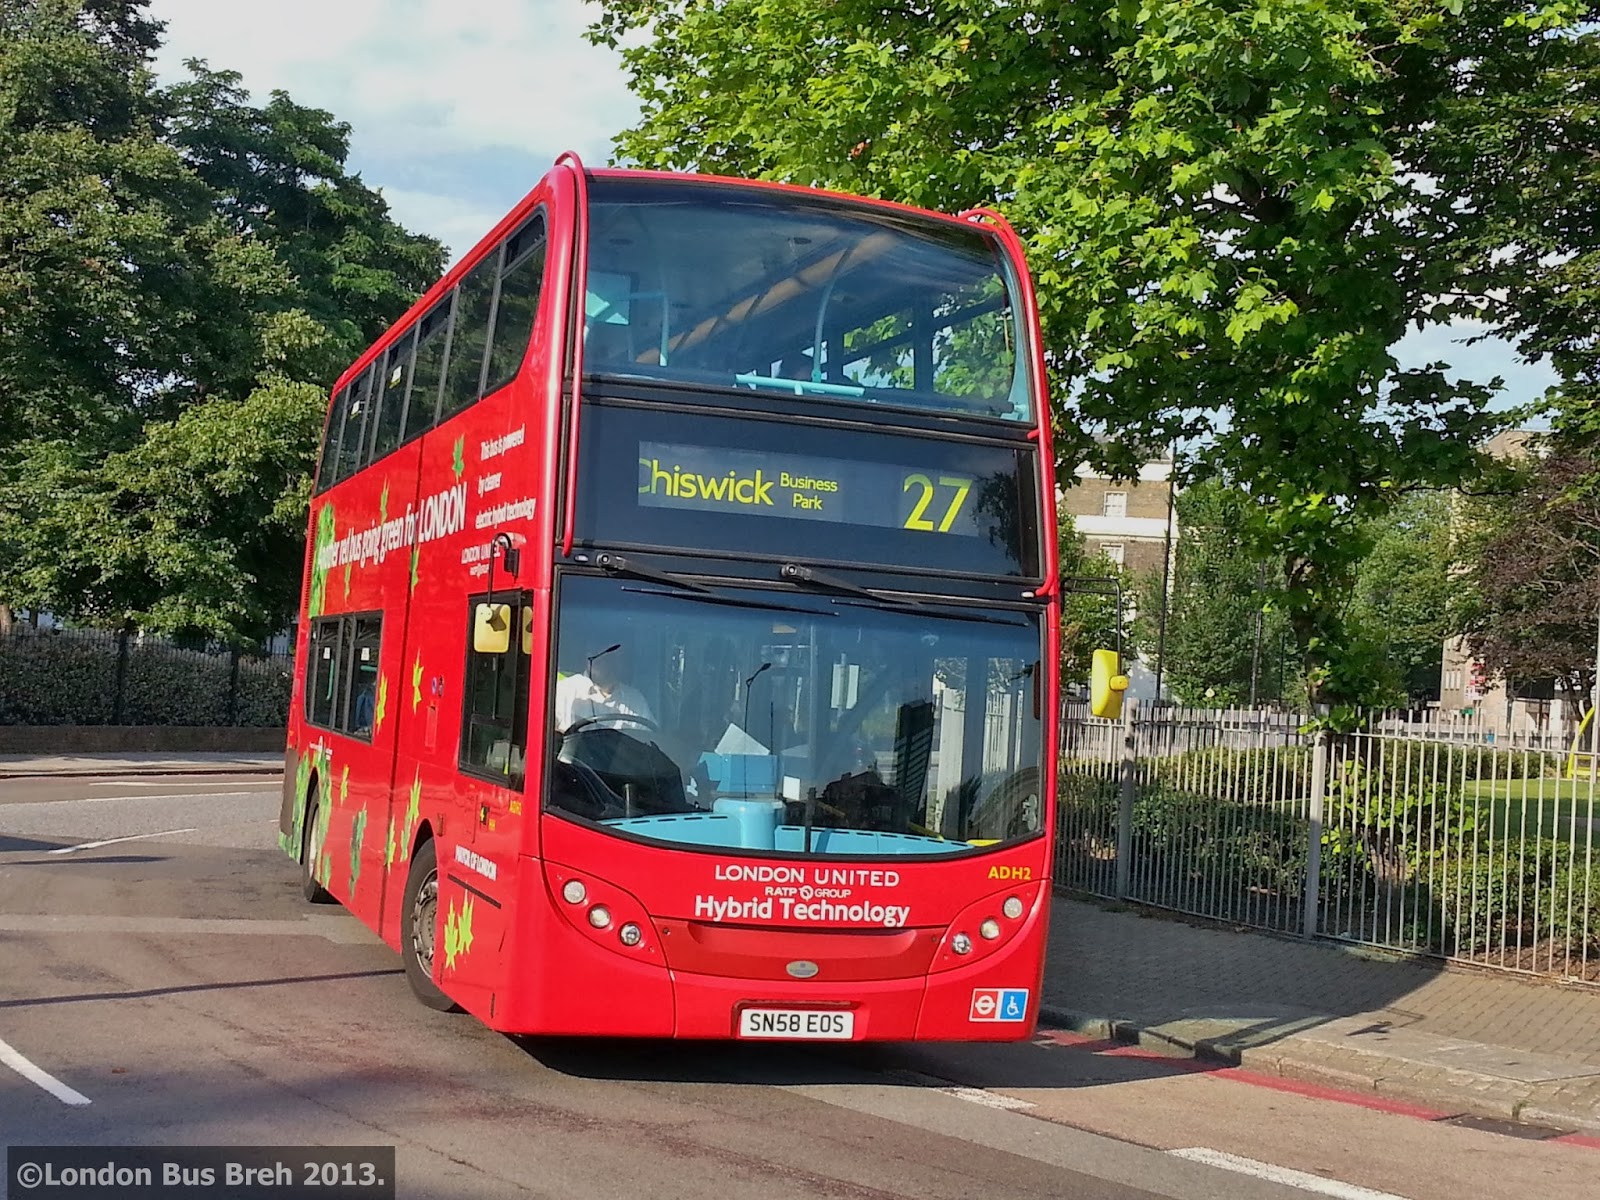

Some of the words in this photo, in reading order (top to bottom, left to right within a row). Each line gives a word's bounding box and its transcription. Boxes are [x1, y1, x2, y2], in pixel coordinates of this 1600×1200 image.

[780, 472, 839, 493] Business
[792, 494, 823, 511] Park
[903, 473, 973, 533] 27
[380, 517, 404, 564] green
[403, 502, 419, 547] for
[418, 481, 468, 544] LONDON
[714, 864, 805, 883] LONDON
[814, 869, 900, 888] UNITED
[987, 865, 1032, 881] ADH2
[765, 886, 798, 897] RATP
[815, 888, 852, 899] GROUP
[694, 895, 773, 922] Hybrid
[779, 897, 911, 928] Technology
[749, 1013, 801, 1033] SN58
[806, 1014, 844, 1034] EOS
